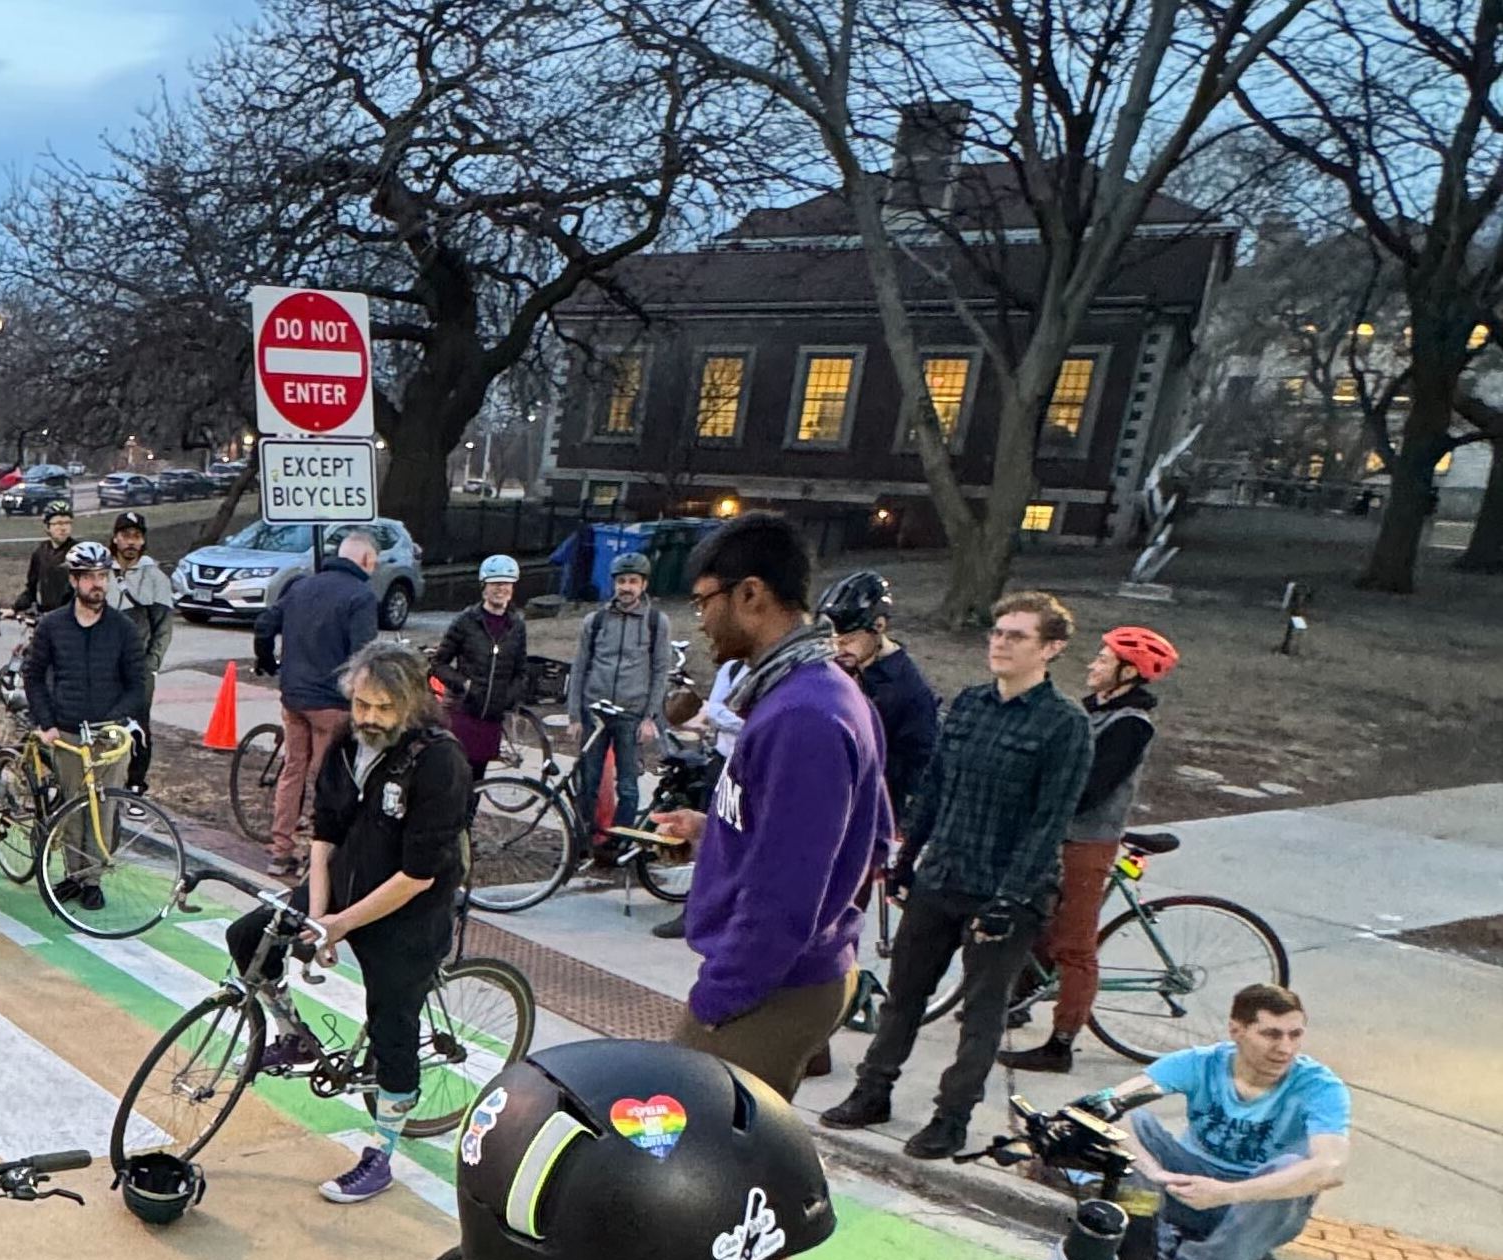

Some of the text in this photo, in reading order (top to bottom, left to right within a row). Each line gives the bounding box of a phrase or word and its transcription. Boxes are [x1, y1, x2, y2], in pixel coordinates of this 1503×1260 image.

[275, 317, 349, 343] DO NOT
[283, 381, 347, 406] ENTER
[283, 457, 354, 478] EXCEPT
[272, 486, 367, 508] BICYCLES
